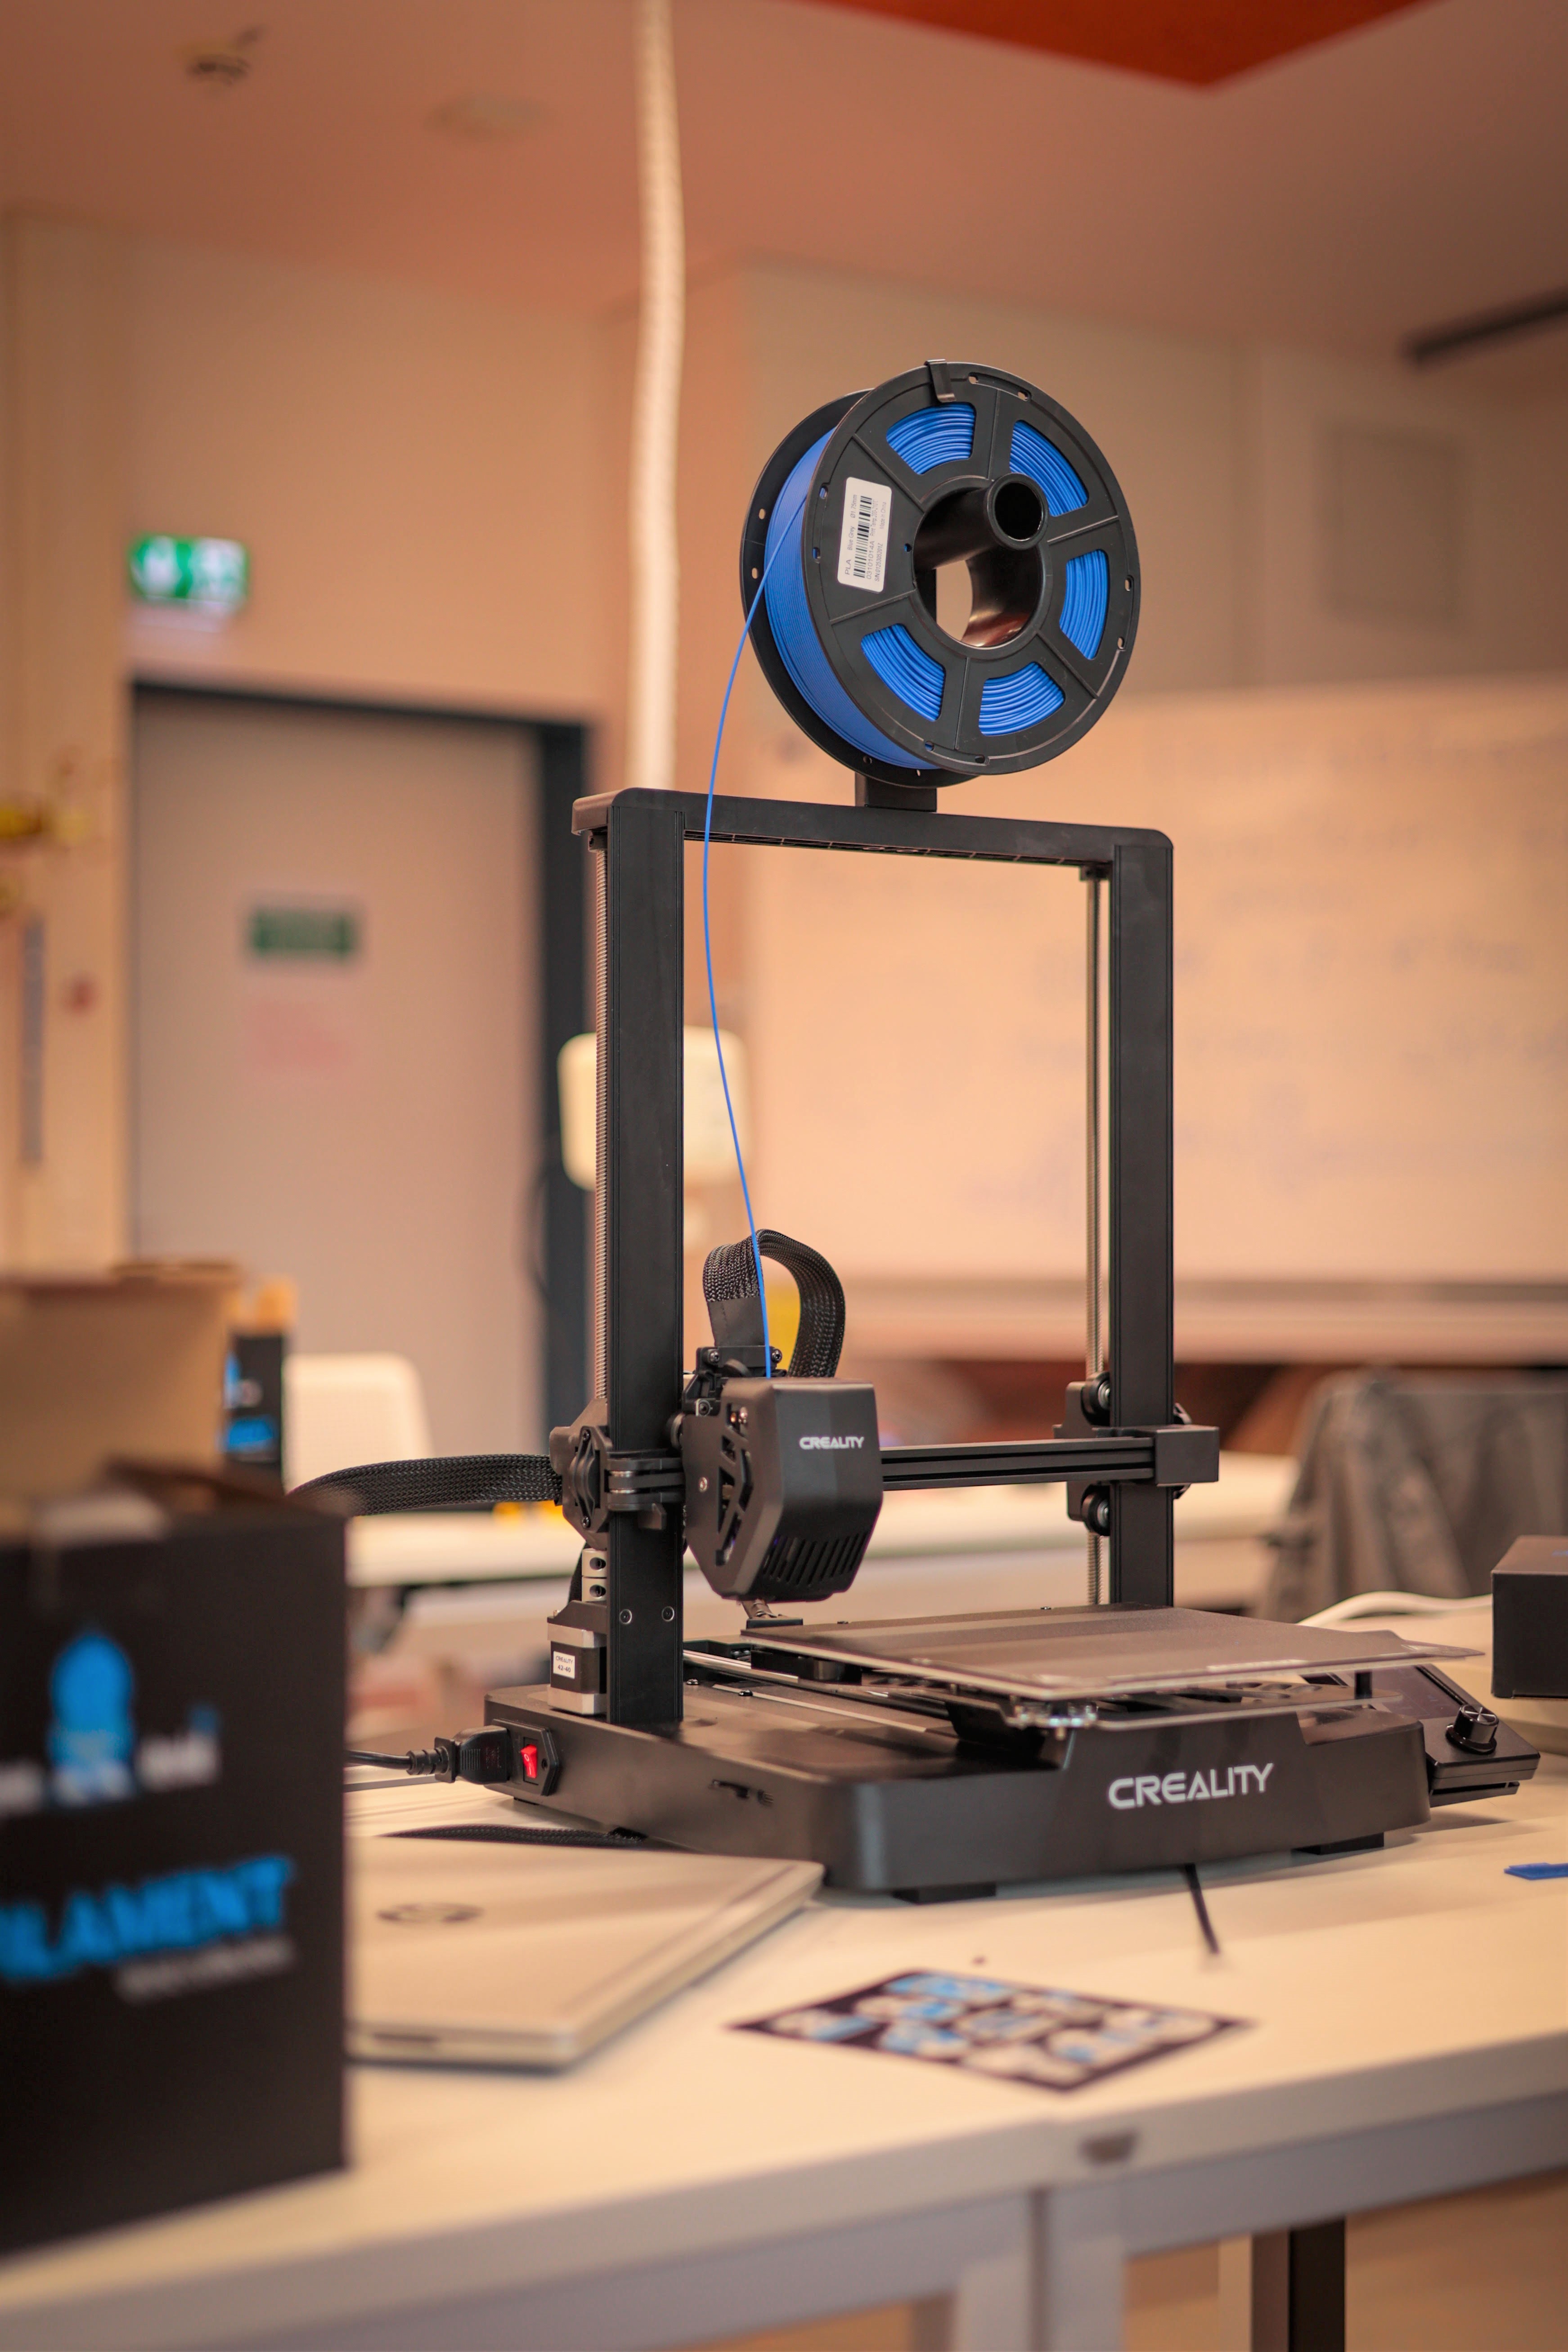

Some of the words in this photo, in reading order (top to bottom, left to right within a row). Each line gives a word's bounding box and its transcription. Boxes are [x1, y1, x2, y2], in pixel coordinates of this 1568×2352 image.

[866, 541, 875, 580] 03101014A
[799, 1436, 865, 1450] CREALITY
[556, 1656, 573, 1664] CREALITY
[557, 1664, 571, 1673] 42-40
[1108, 1762, 1275, 1810] CREALITY
